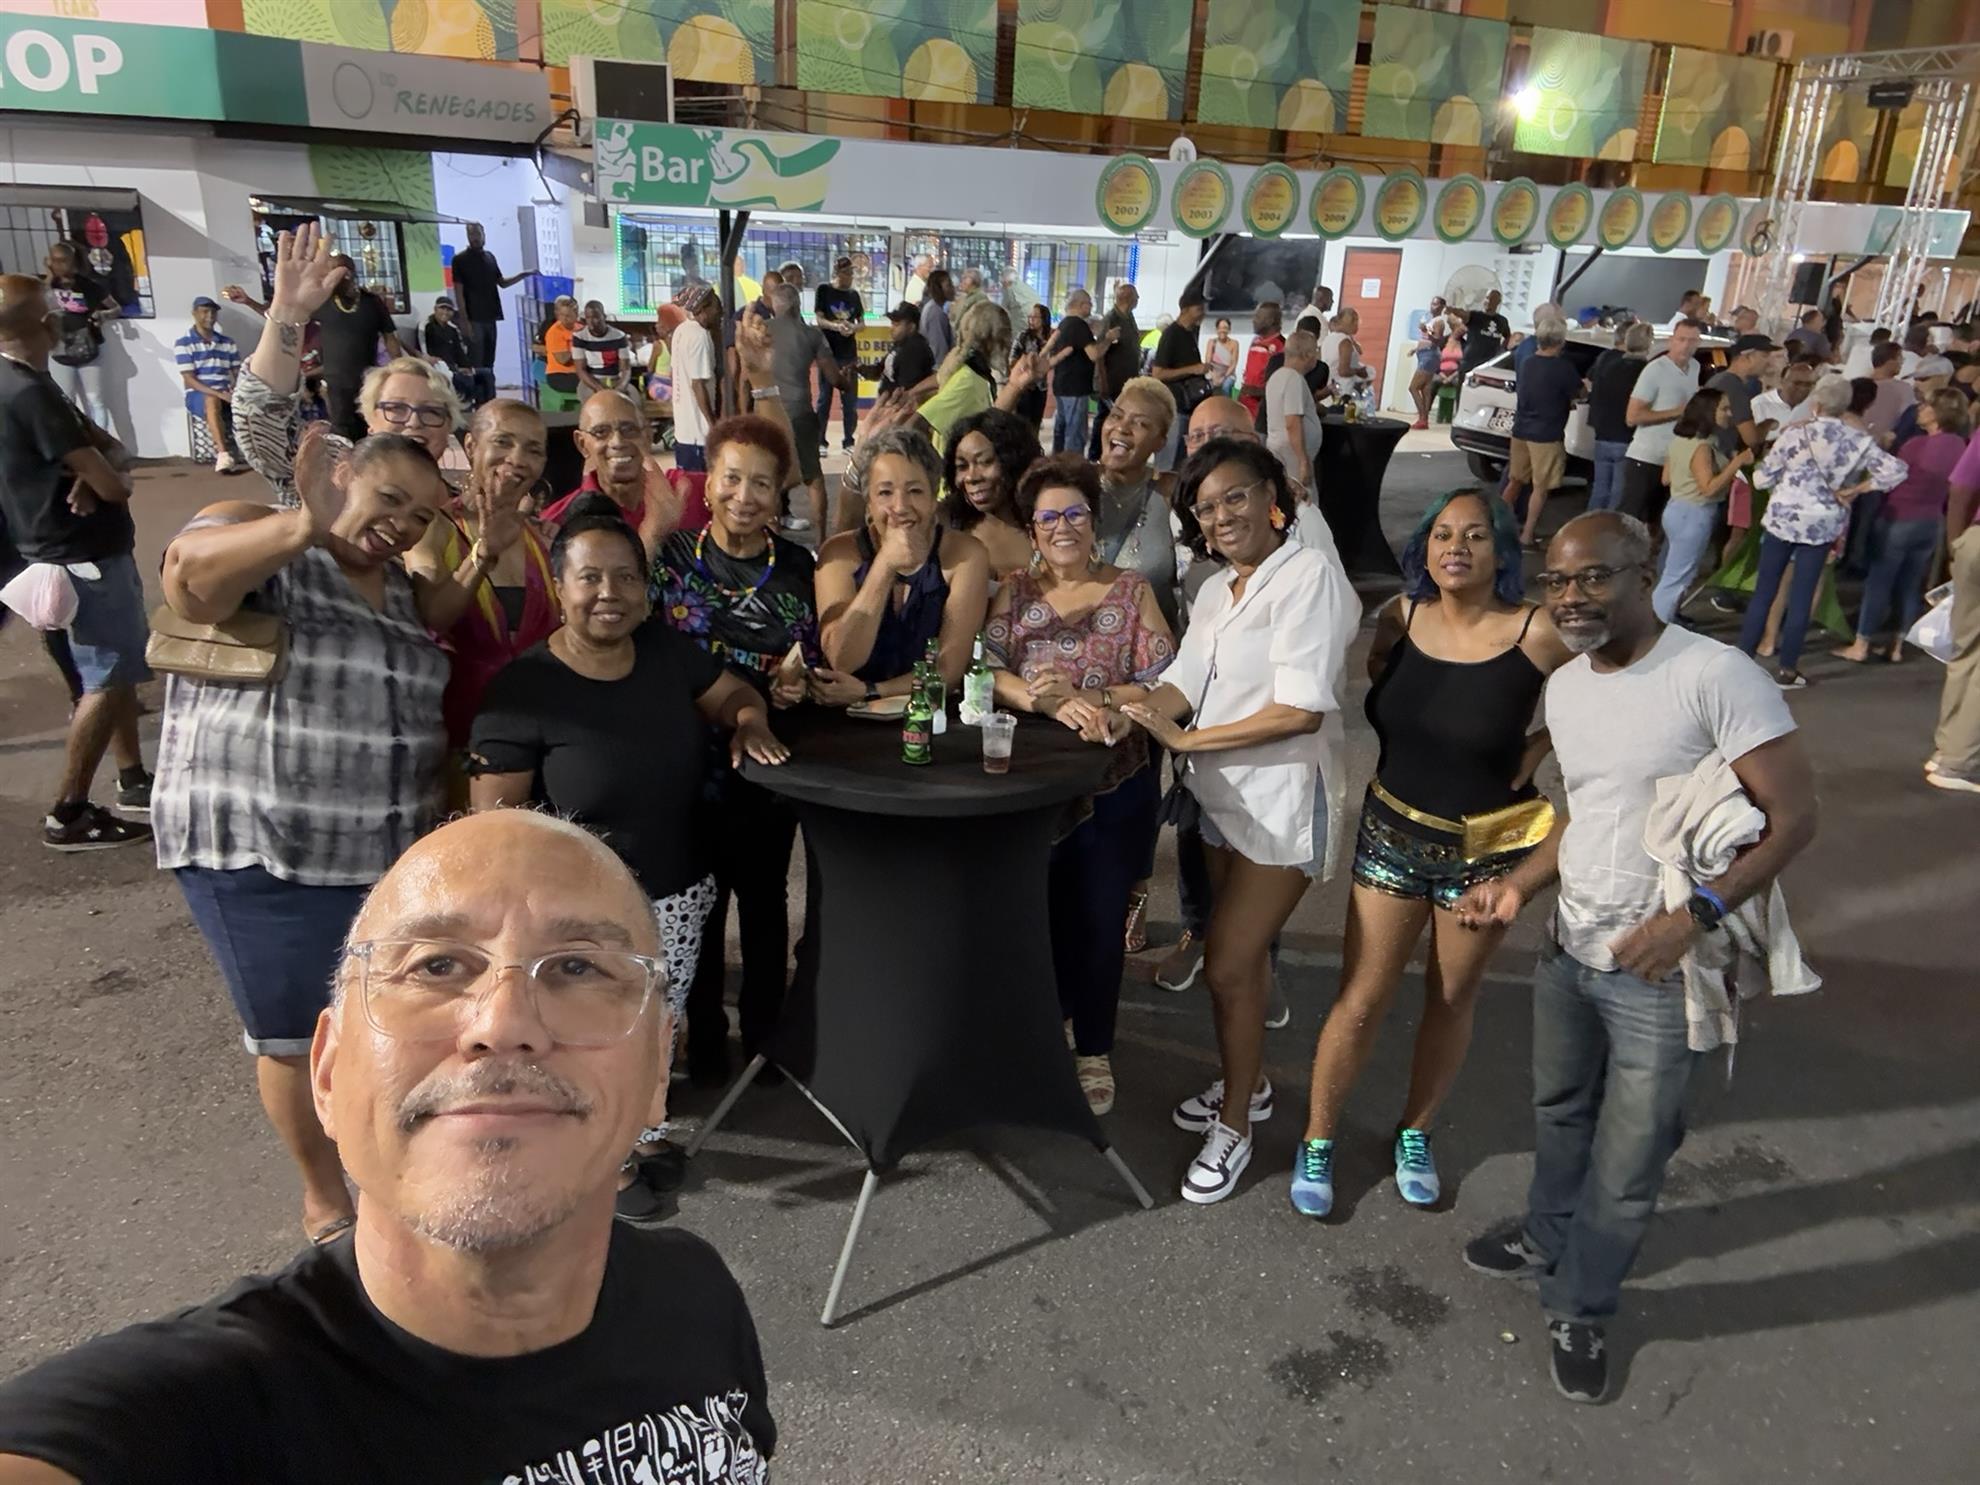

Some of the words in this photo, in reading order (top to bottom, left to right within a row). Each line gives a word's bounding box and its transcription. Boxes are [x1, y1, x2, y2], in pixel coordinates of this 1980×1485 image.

[0, 29, 124, 94] OP
[394, 90, 537, 122] RENEGADES
[642, 146, 704, 184] Bar
[1115, 206, 1139, 216] 2002
[1189, 210, 1213, 219] 2003
